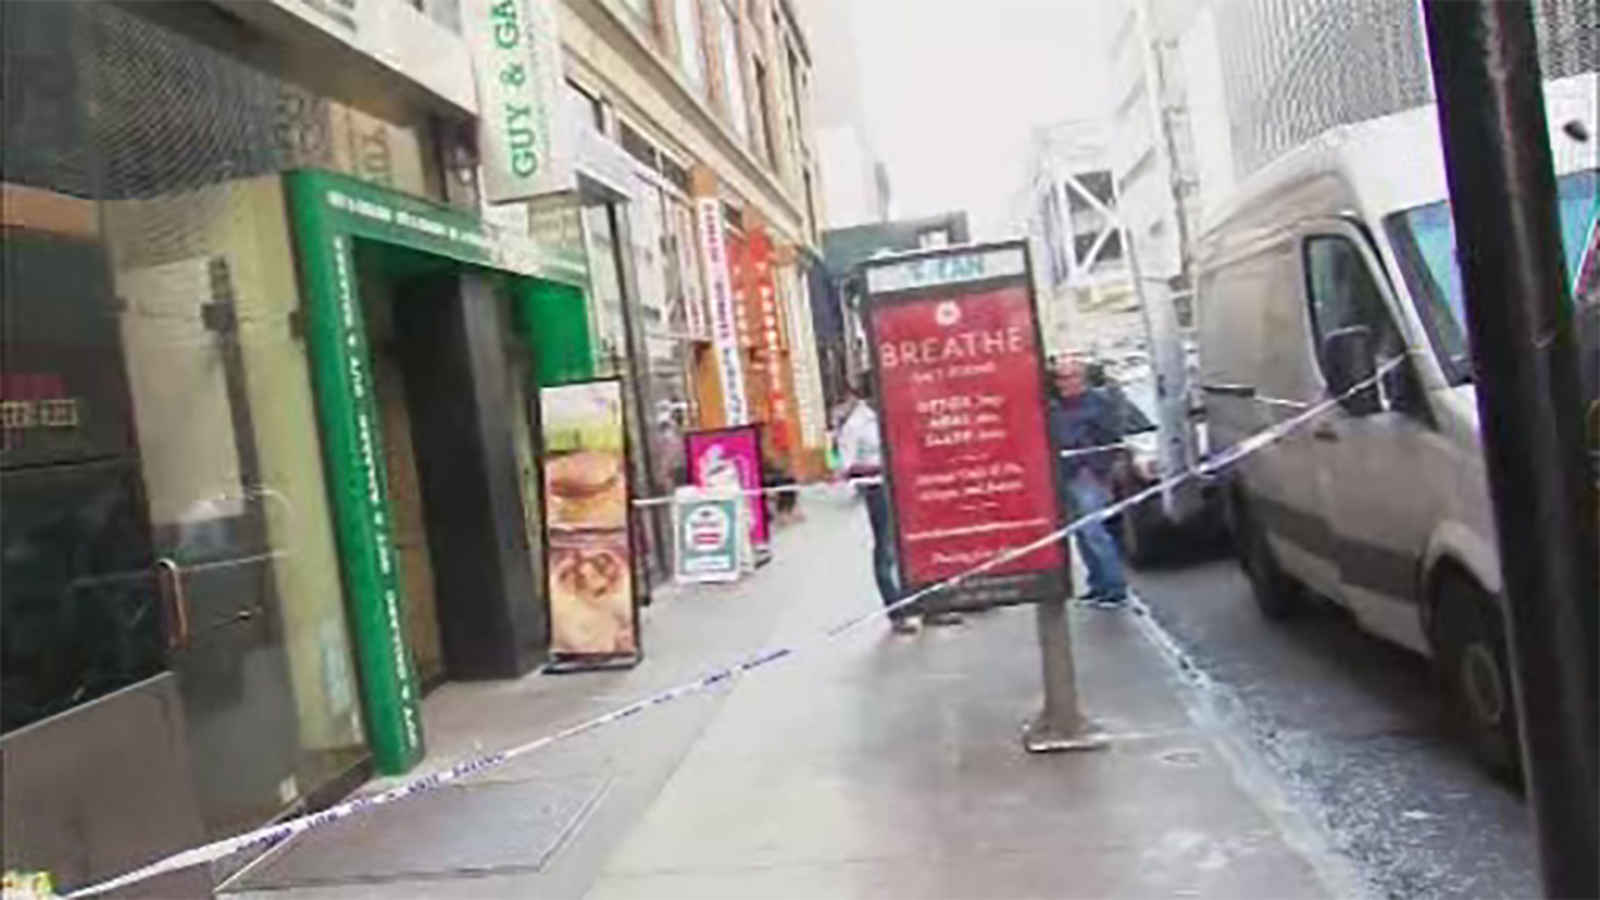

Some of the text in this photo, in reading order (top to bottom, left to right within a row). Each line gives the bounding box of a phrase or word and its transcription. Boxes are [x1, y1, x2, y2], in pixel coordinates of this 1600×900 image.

[499, 62, 526, 88] &
[505, 104, 537, 178] GUY
[880, 326, 1025, 369] BREATHE
